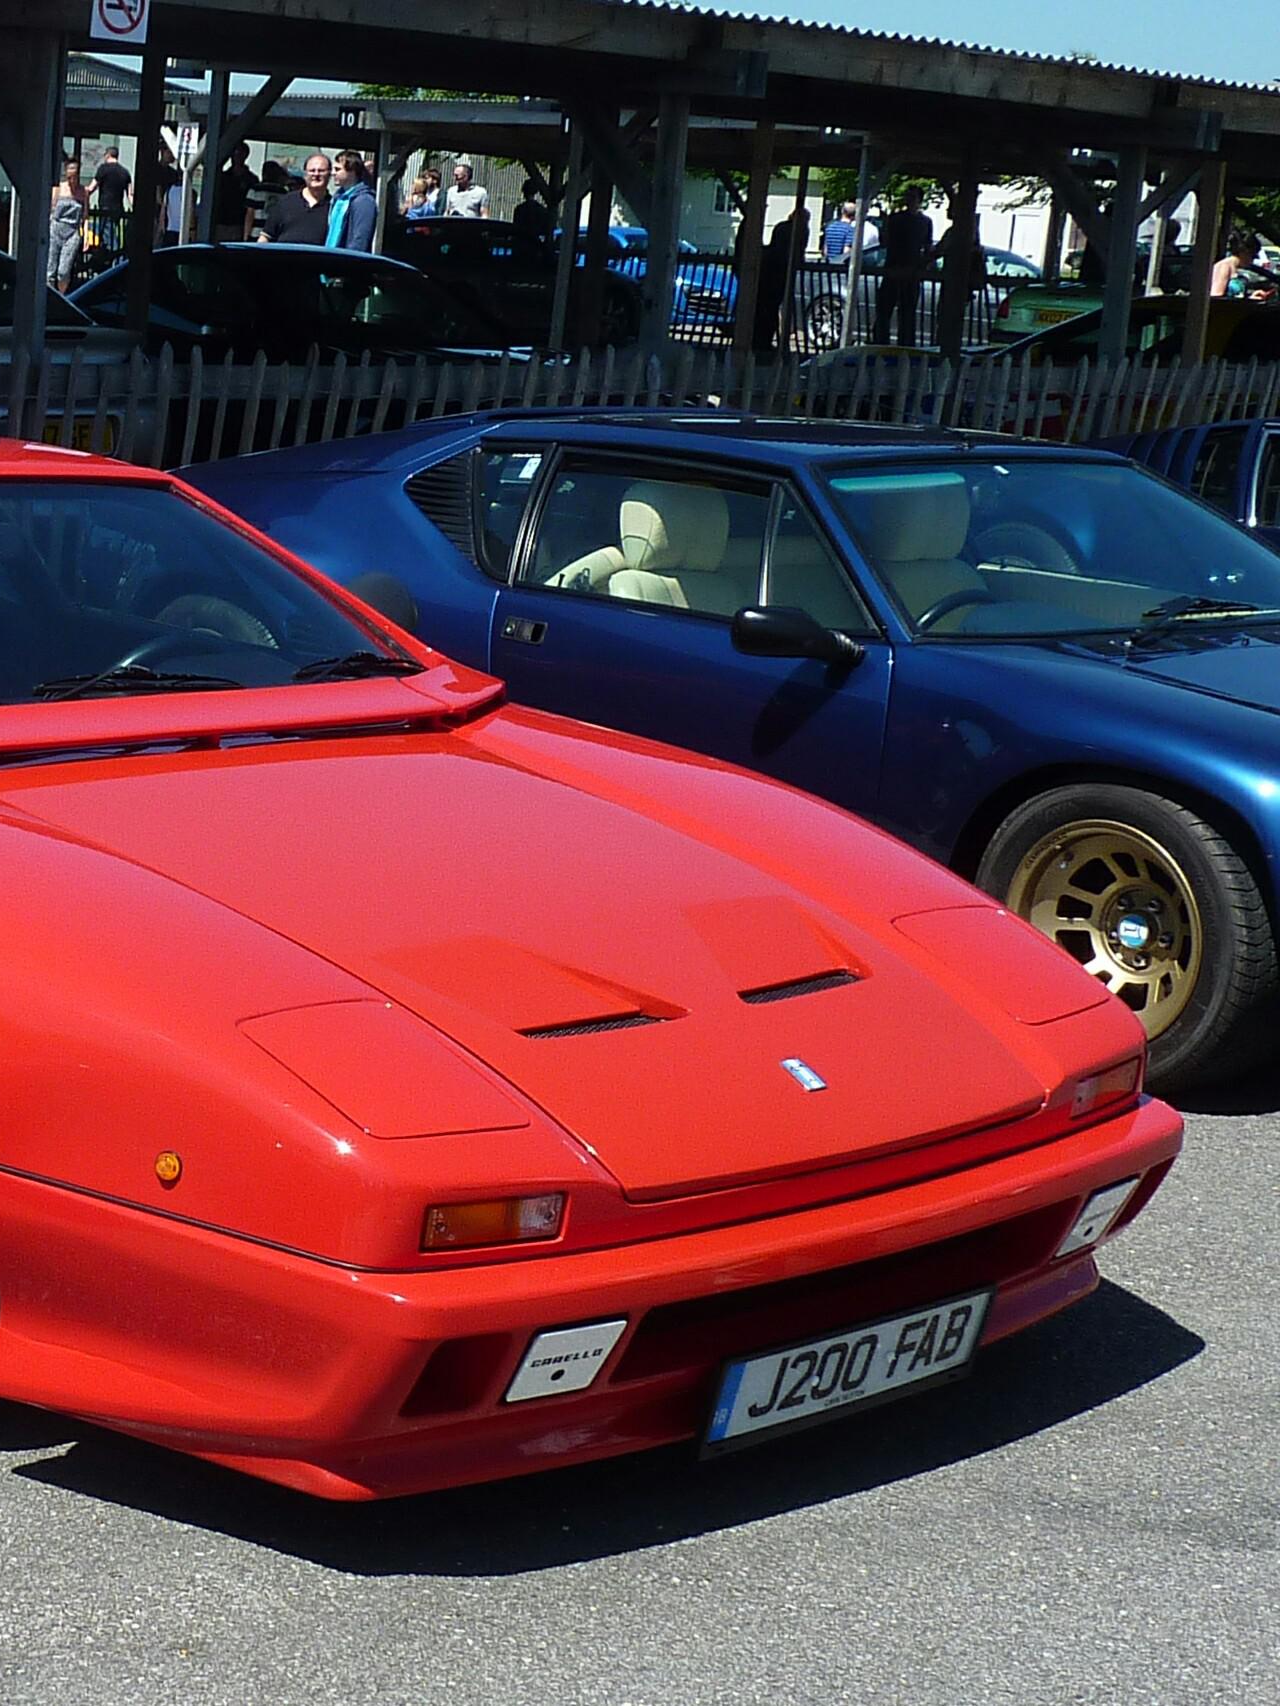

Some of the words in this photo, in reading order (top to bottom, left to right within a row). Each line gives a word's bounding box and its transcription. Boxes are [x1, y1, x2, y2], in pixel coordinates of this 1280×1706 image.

[341, 111, 355, 127] 10
[530, 1347, 604, 1369] CARELLO
[747, 1333, 879, 1418] J200
[885, 1304, 973, 1379] FAB
